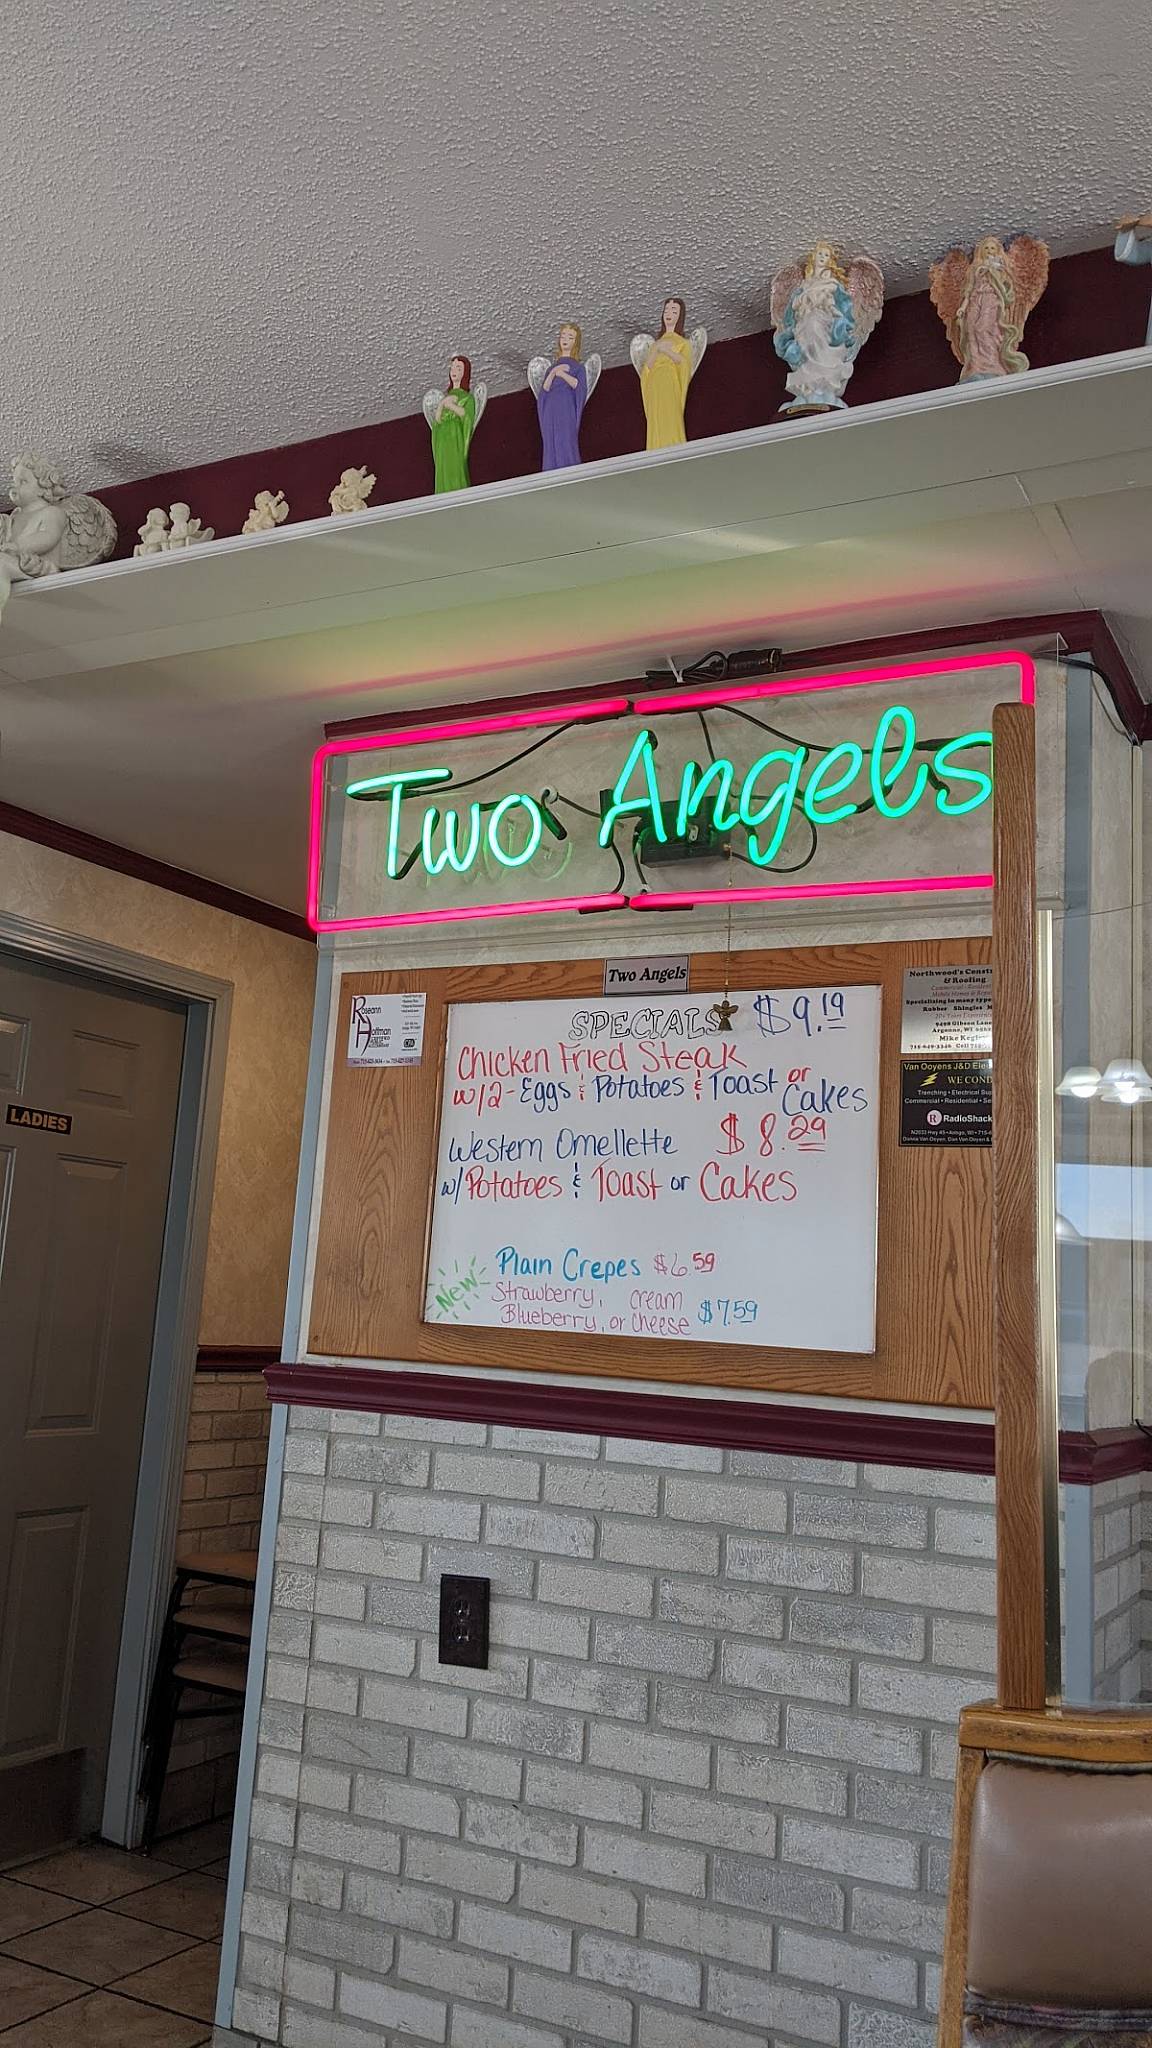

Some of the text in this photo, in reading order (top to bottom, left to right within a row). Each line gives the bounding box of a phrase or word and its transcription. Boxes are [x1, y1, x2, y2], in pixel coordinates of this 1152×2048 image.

[346, 705, 994, 881] Two Angels
[609, 966, 687, 983] Two Angels
[909, 967, 963, 977] Northwood's
[952, 976, 987, 984] Roofing
[567, 1007, 722, 1041] SPECIALS
[458, 1040, 748, 1081] Chicken Fried Steak
[904, 1062, 919, 1070] Van
[920, 1062, 952, 1072] Ooyens
[953, 1062, 971, 1070] J&D
[708, 1066, 779, 1101] Toast
[787, 1066, 812, 1083] or
[947, 1075, 963, 1084] WE
[519, 1076, 571, 1114] Eggs
[591, 1074, 685, 1103] Potatoes
[781, 1077, 869, 1117] Cakes
[904, 1097, 940, 1105] Commercial
[10, 1108, 68, 1131] LADIES
[943, 1114, 993, 1123] RadioShack
[556, 1127, 679, 1161] Omellette
[590, 1157, 663, 1203] Toast
[670, 1174, 691, 1191] or
[699, 1160, 798, 1203] Cakes
[496, 1245, 552, 1276] Plain
[562, 1247, 641, 1284] Crepes
[609, 1315, 626, 1332] or
